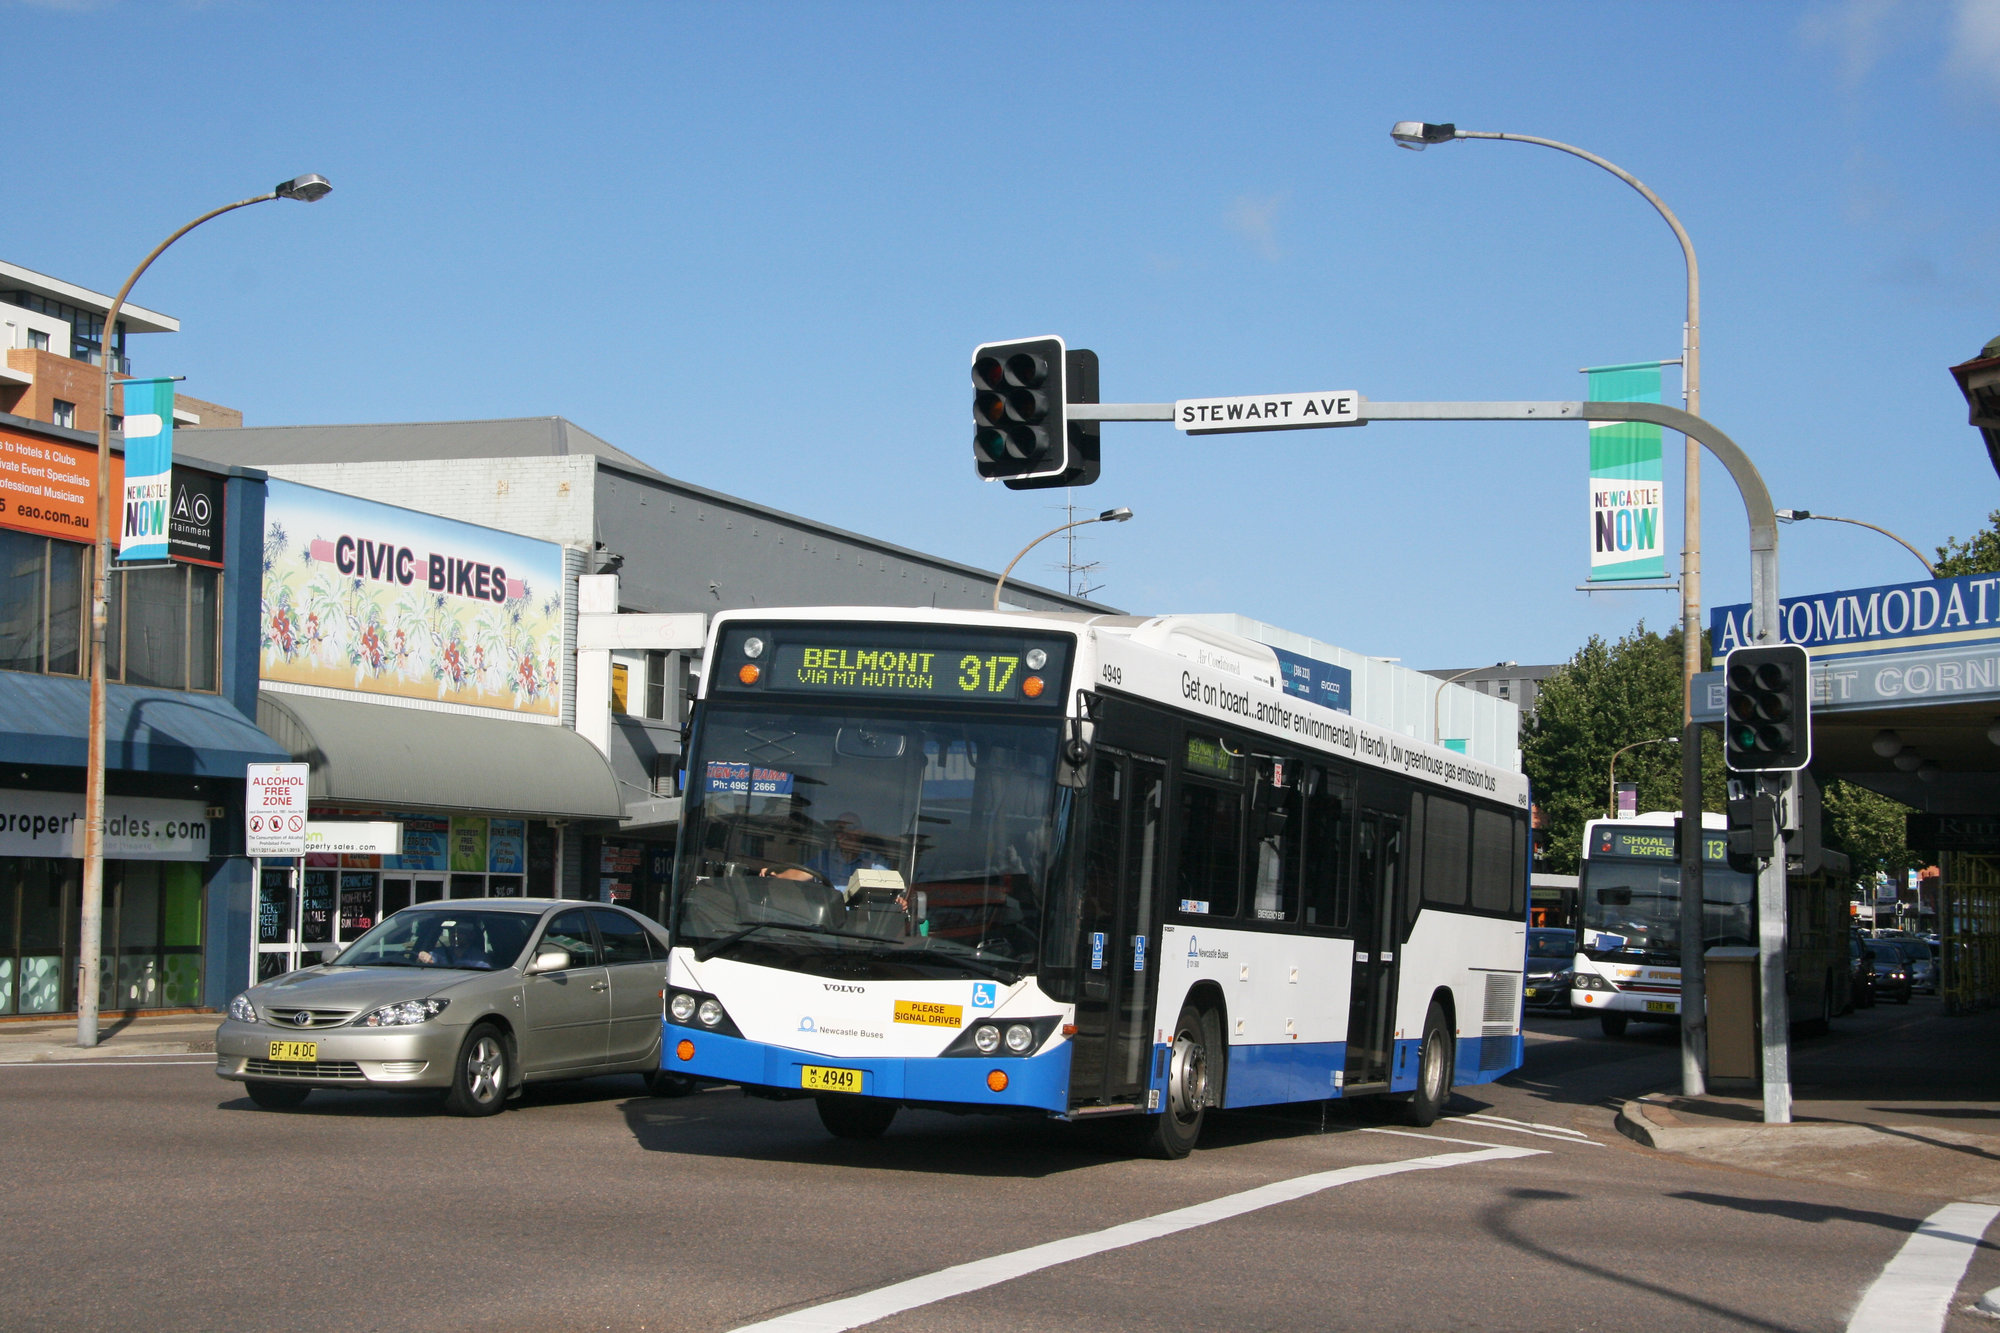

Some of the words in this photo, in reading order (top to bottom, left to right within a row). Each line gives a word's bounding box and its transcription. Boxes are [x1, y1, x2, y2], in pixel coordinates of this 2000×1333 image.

[1182, 400, 1292, 422] STEWART
[1302, 398, 1350, 416] AVE
[5, 441, 14, 452] to
[16, 443, 42, 459] Hotels
[45, 450, 50, 460] &
[53, 452, 76, 466] Clubs
[22, 463, 44, 478] Event
[47, 468, 90, 487] Specialists
[44, 486, 84, 504] Musicians
[128, 484, 167, 500] NEWCASTLE
[1595, 488, 1658, 508] NEWCASTLE
[18, 504, 88, 528] eao.com.au
[177, 496, 208, 520] AO
[125, 500, 166, 536] NOW
[171, 522, 210, 537] rtainment
[1595, 508, 1658, 552] NOW
[336, 535, 415, 586] CIVIC
[428, 552, 506, 604] BIKES
[1720, 578, 2000, 650] AOMMODAT
[798, 668, 827, 684] VIA
[834, 671, 856, 685] MT
[862, 670, 933, 689] HUTTON
[803, 648, 934, 672] BELMONT
[958, 655, 1018, 692] 317
[1102, 664, 1122, 685] 4949
[1707, 670, 1858, 710] BET
[1874, 658, 2000, 696] CORN
[1182, 671, 1200, 702] Get
[1204, 684, 1216, 706] on
[1294, 711, 1358, 756] environmentally
[1360, 730, 1388, 764] friendly,
[1390, 739, 1403, 764] low
[1404, 749, 1443, 776] greenhouse
[1444, 760, 1456, 782] gas
[1457, 761, 1484, 789] emission
[1484, 770, 1496, 792] bus
[253, 777, 304, 786] ALCOHOL
[713, 780, 728, 788] Ph:
[754, 783, 776, 791] 2666
[264, 787, 290, 796] FREE
[263, 797, 292, 806] ZONE
[0, 812, 84, 839] ropert
[306, 843, 330, 853] operty
[1622, 836, 1666, 846] SHOAL
[1630, 846, 1674, 856] EXPRE
[1707, 840, 1728, 859] 13
[654, 857, 672, 874] 810
[260, 902, 285, 914] NTEREST
[312, 910, 326, 922] SALE
[341, 918, 352, 928] SUN
[352, 918, 371, 928] CLOSED
[1198, 948, 1217, 958] Newcastle
[1218, 948, 1228, 959] Buses
[823, 984, 865, 994] VOLVO
[912, 1004, 945, 1014] PLEASE
[894, 1012, 926, 1022] SIGNAL
[929, 1015, 960, 1025] DRIVER
[820, 1026, 858, 1036] Newcastle
[860, 1030, 884, 1038] Buses
[271, 1043, 284, 1056] BF
[289, 1044, 298, 1056] 14
[302, 1044, 314, 1057] DC
[822, 1070, 853, 1086] 4949
